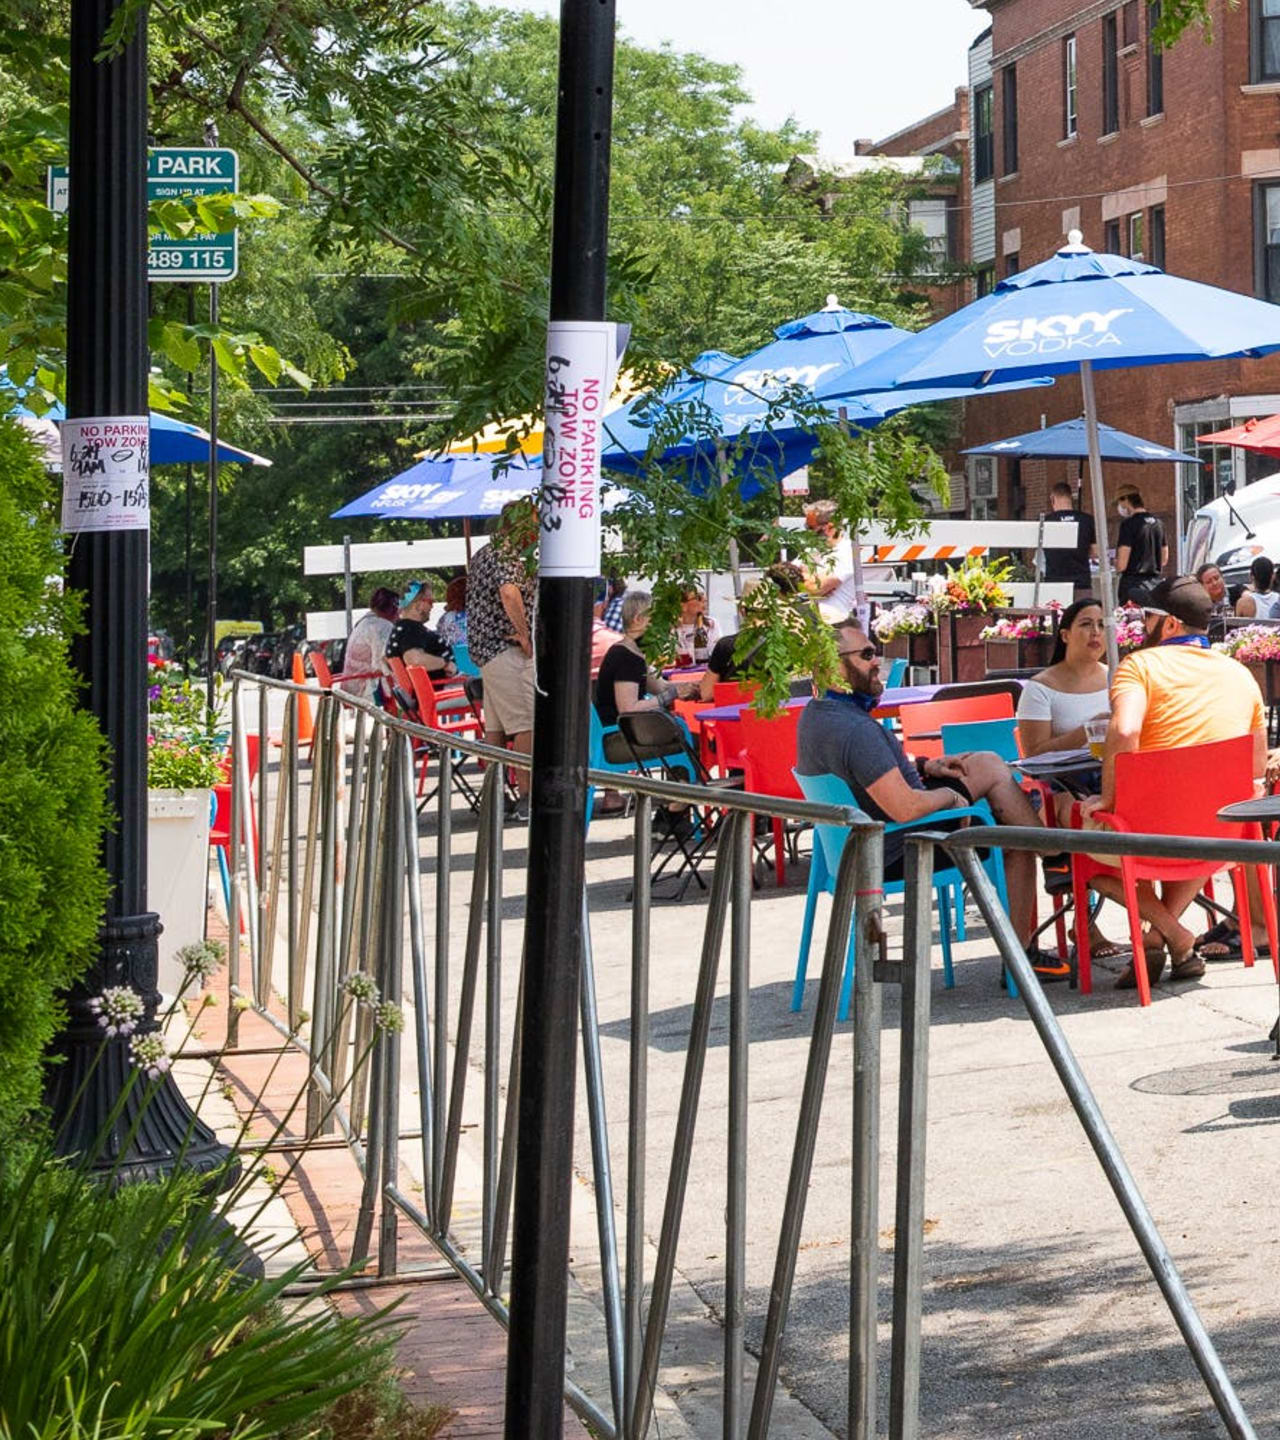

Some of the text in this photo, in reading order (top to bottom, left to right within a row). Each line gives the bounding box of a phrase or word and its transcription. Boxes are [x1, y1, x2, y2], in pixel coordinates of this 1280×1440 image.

[157, 157, 222, 175] PARK
[156, 188, 177, 196] SIGN
[148, 251, 225, 268] 489 115
[983, 308, 1135, 344] SKYY
[983, 332, 1122, 358] VODKA
[81, 425, 147, 437] NO PARKIN
[87, 437, 147, 448] TOW ZON
[557, 389, 578, 509] TOW ZONE
[579, 379, 600, 519] NO PARKING
